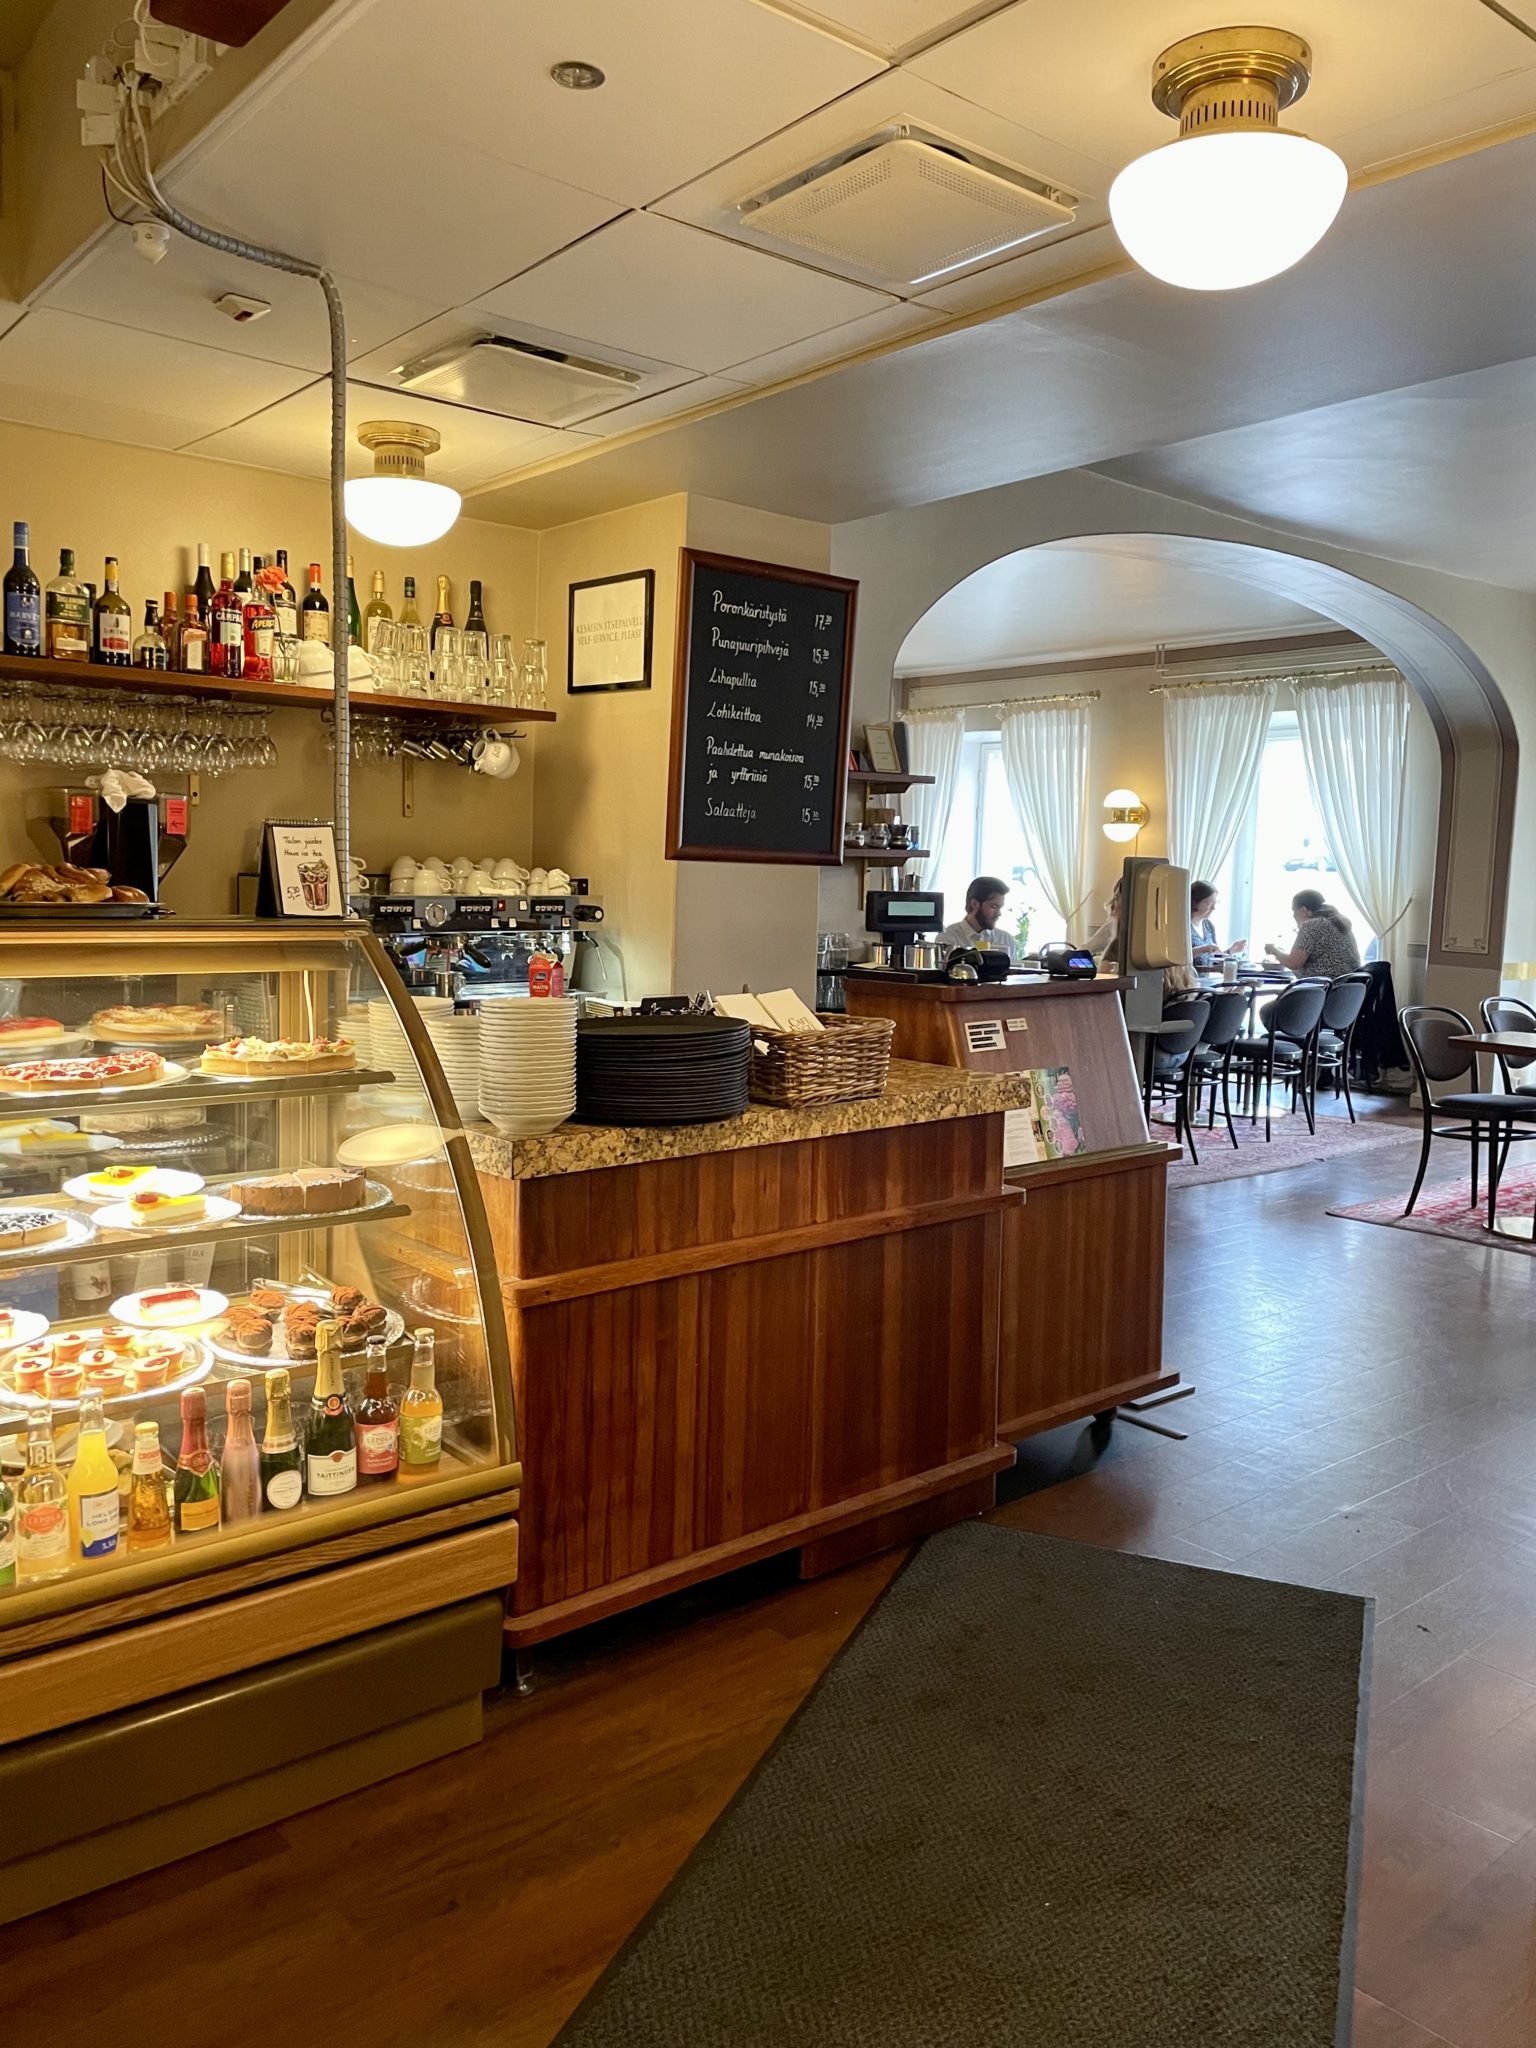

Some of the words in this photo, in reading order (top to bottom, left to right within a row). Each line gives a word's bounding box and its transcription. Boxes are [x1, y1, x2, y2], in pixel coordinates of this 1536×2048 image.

[712, 589, 788, 628] Poronkäristystä
[711, 626, 790, 661] Punajuuripihvejä
[708, 667, 757, 690] Lihapullia
[707, 701, 762, 723] Lohikeittoa
[706, 735, 753, 758] Paahdettua
[706, 762, 718, 785] ja
[705, 797, 757, 824] Salaatteja
